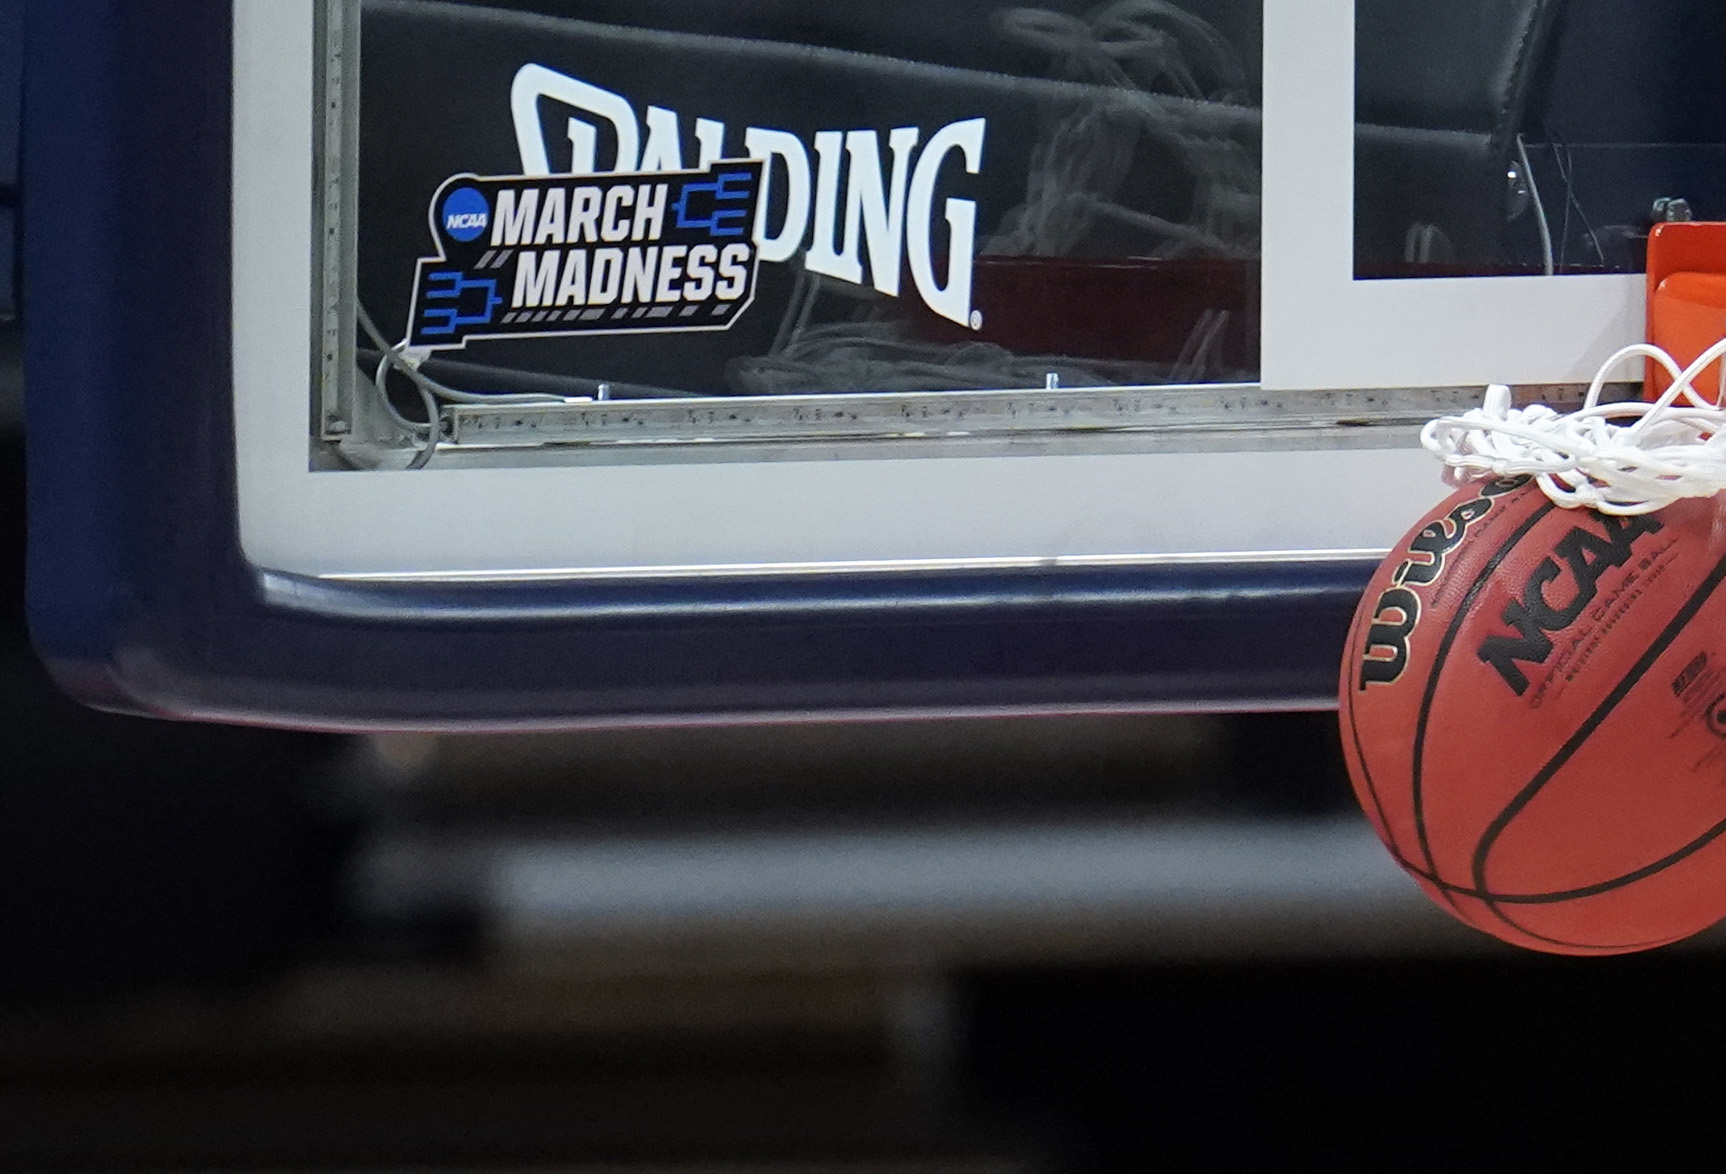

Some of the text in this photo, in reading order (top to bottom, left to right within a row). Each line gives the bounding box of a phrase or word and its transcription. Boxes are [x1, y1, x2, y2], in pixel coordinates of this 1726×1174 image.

[445, 213, 488, 229] NCAA
[490, 183, 669, 246] MARCH
[511, 242, 750, 308] MADNESS
[1358, 474, 1535, 692] Wilso
[1476, 511, 1664, 697] NCAA
[1592, 570, 1640, 631] GAME
